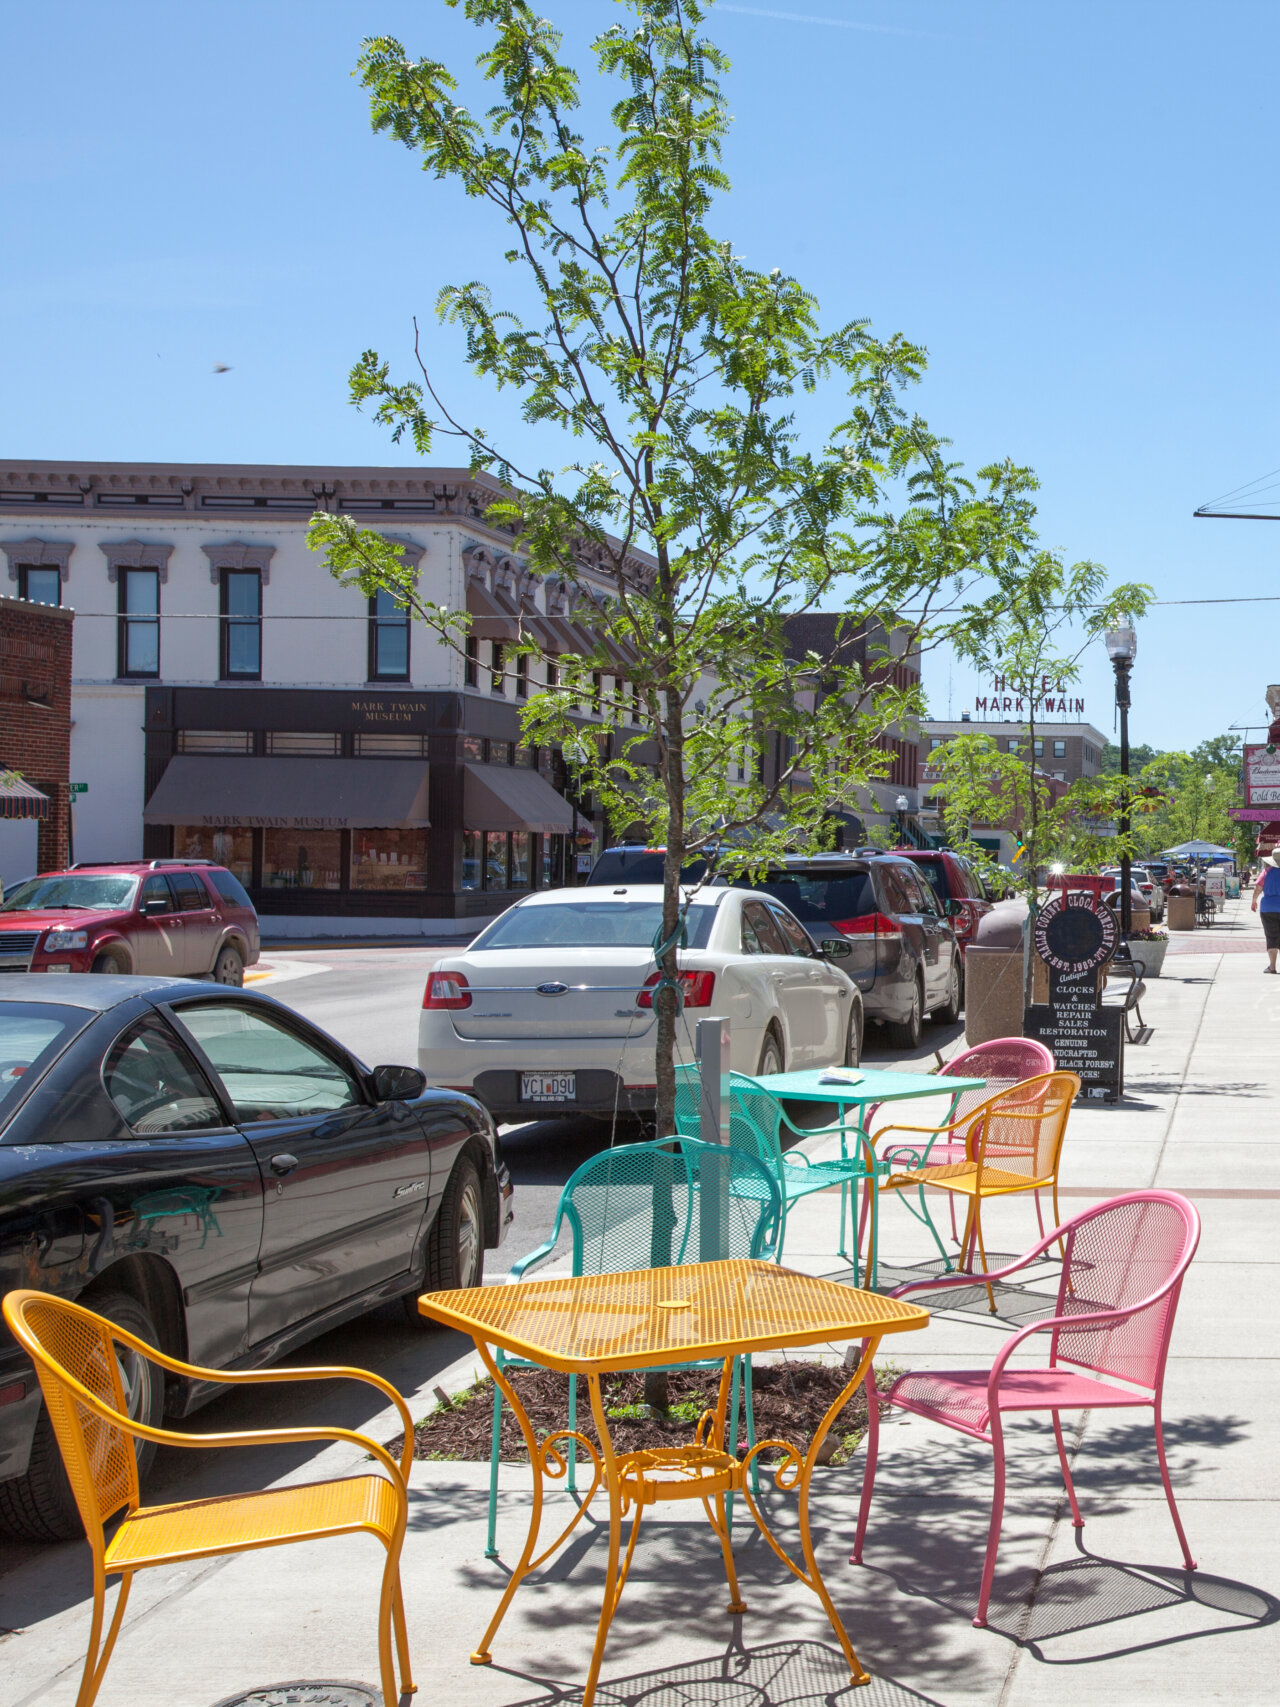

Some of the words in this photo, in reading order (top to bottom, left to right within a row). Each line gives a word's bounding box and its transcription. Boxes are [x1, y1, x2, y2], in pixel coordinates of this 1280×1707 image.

[351, 702, 384, 711] MARK
[390, 703, 428, 712] TWAIN
[975, 696, 1024, 712] MARK
[365, 712, 412, 721] MUSEUM
[1251, 789, 1270, 801] Cold
[202, 815, 242, 825] MARK
[245, 816, 288, 826] TWAIN
[293, 816, 349, 827] MUSEUM
[1036, 898, 1063, 928] COUNT
[1094, 906, 1115, 949] COMPANY
[1059, 970, 1089, 983] Antique
[1056, 986, 1095, 994] CLOCKS
[1071, 994, 1079, 1002] &
[1053, 1003, 1096, 1011] WATCHES
[1056, 1011, 1092, 1019] REPAIR
[1058, 1020, 1089, 1028] SALES
[1039, 1028, 1108, 1037] RESTORATION
[1054, 1039, 1088, 1047] GENUINE
[1051, 1049, 1098, 1058] NDCRAFTED
[1059, 1060, 1083, 1068] BLACK
[1085, 1061, 1115, 1069] FOREST
